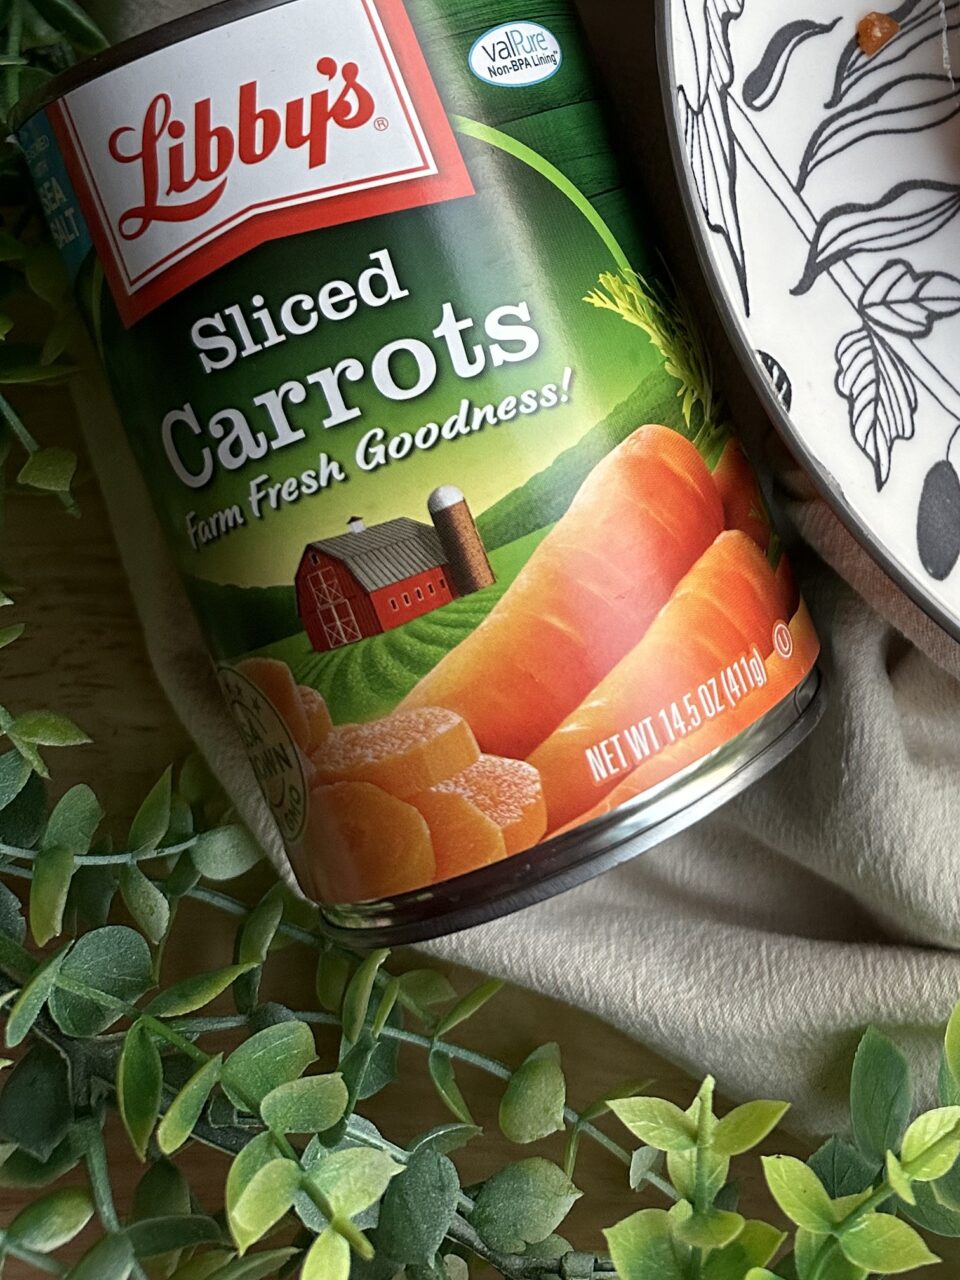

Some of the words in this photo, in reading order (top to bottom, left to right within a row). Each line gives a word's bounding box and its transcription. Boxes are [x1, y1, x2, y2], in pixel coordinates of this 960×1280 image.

[481, 29, 549, 63] valPure
[486, 56, 533, 79] Non-BPA
[108, 57, 376, 241] Libby's
[190, 248, 410, 374] Sliced
[161, 301, 540, 489] Carrots
[185, 503, 246, 550] Farm
[248, 453, 346, 518] Fresh
[355, 366, 573, 471] Goodness!
[584, 734, 628, 783] NET
[623, 716, 661, 761] WT
[658, 692, 702, 743] 14.5
[697, 676, 726, 718] OZ
[720, 647, 768, 707] (411g)
